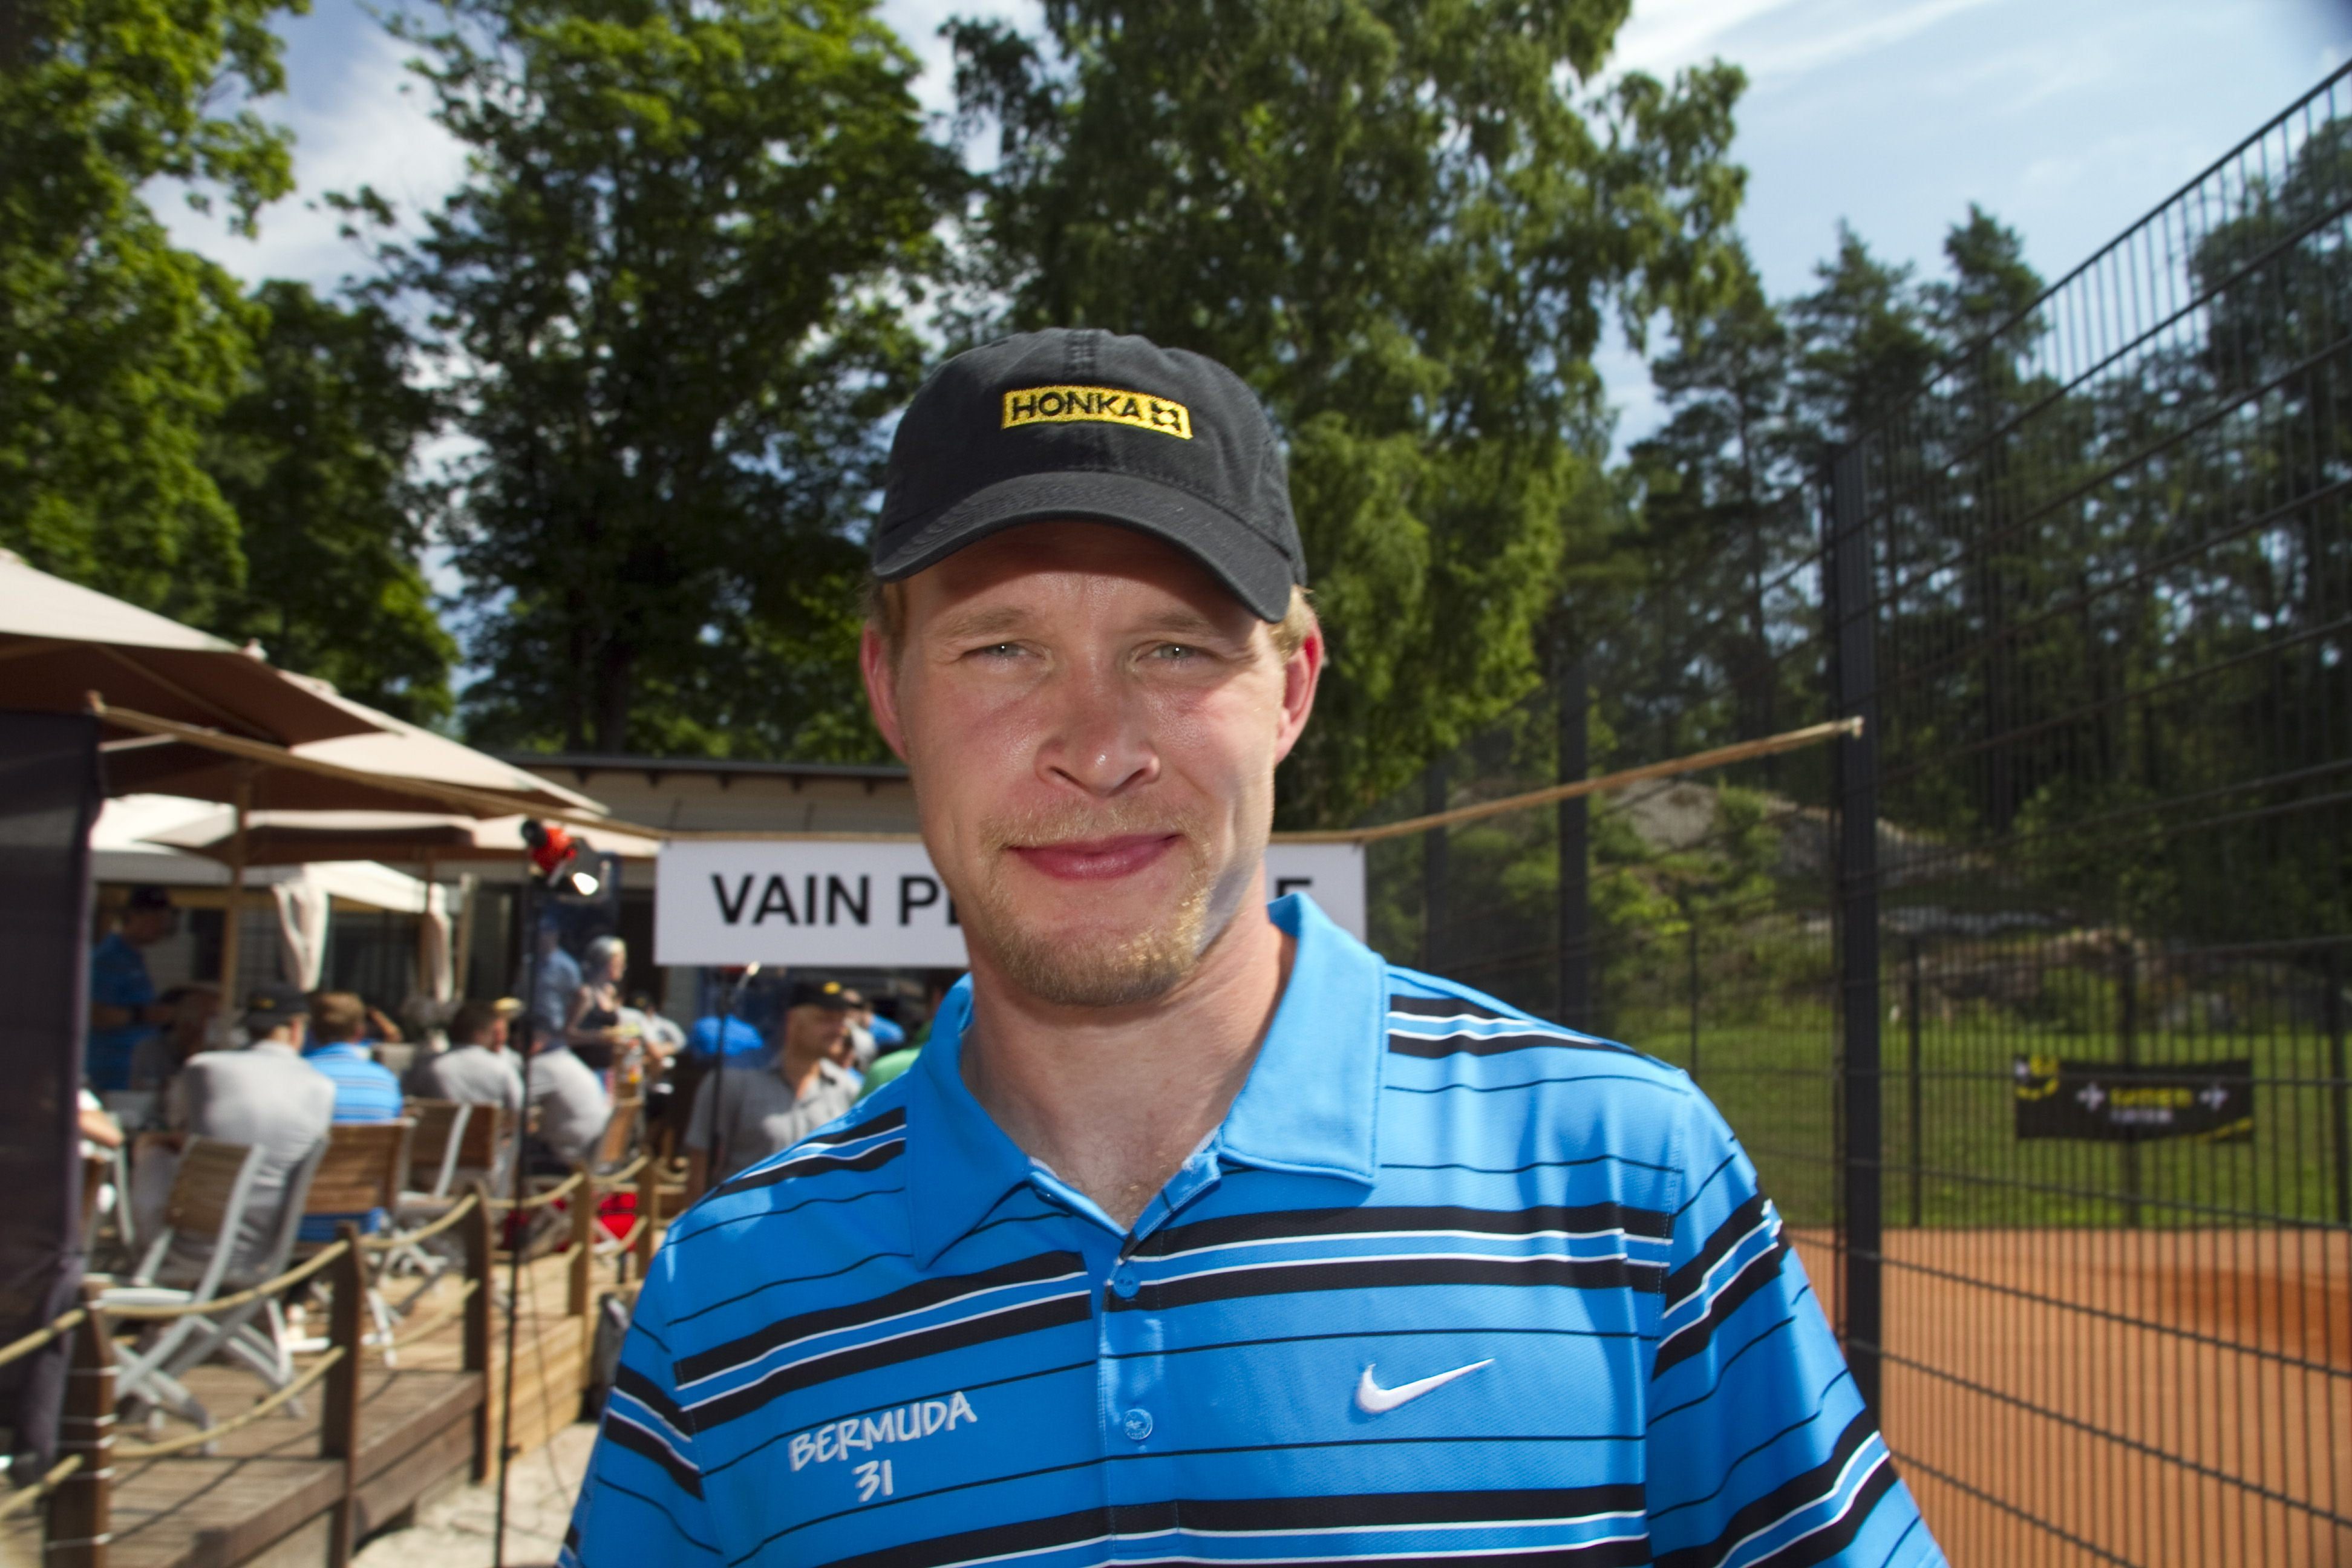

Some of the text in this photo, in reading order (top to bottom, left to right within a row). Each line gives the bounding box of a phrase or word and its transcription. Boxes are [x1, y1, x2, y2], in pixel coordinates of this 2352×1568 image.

[1012, 391, 1143, 420] HONKA
[711, 874, 871, 926] VAIN
[788, 1391, 978, 1472] BERMUDA
[852, 1459, 893, 1503] 31
